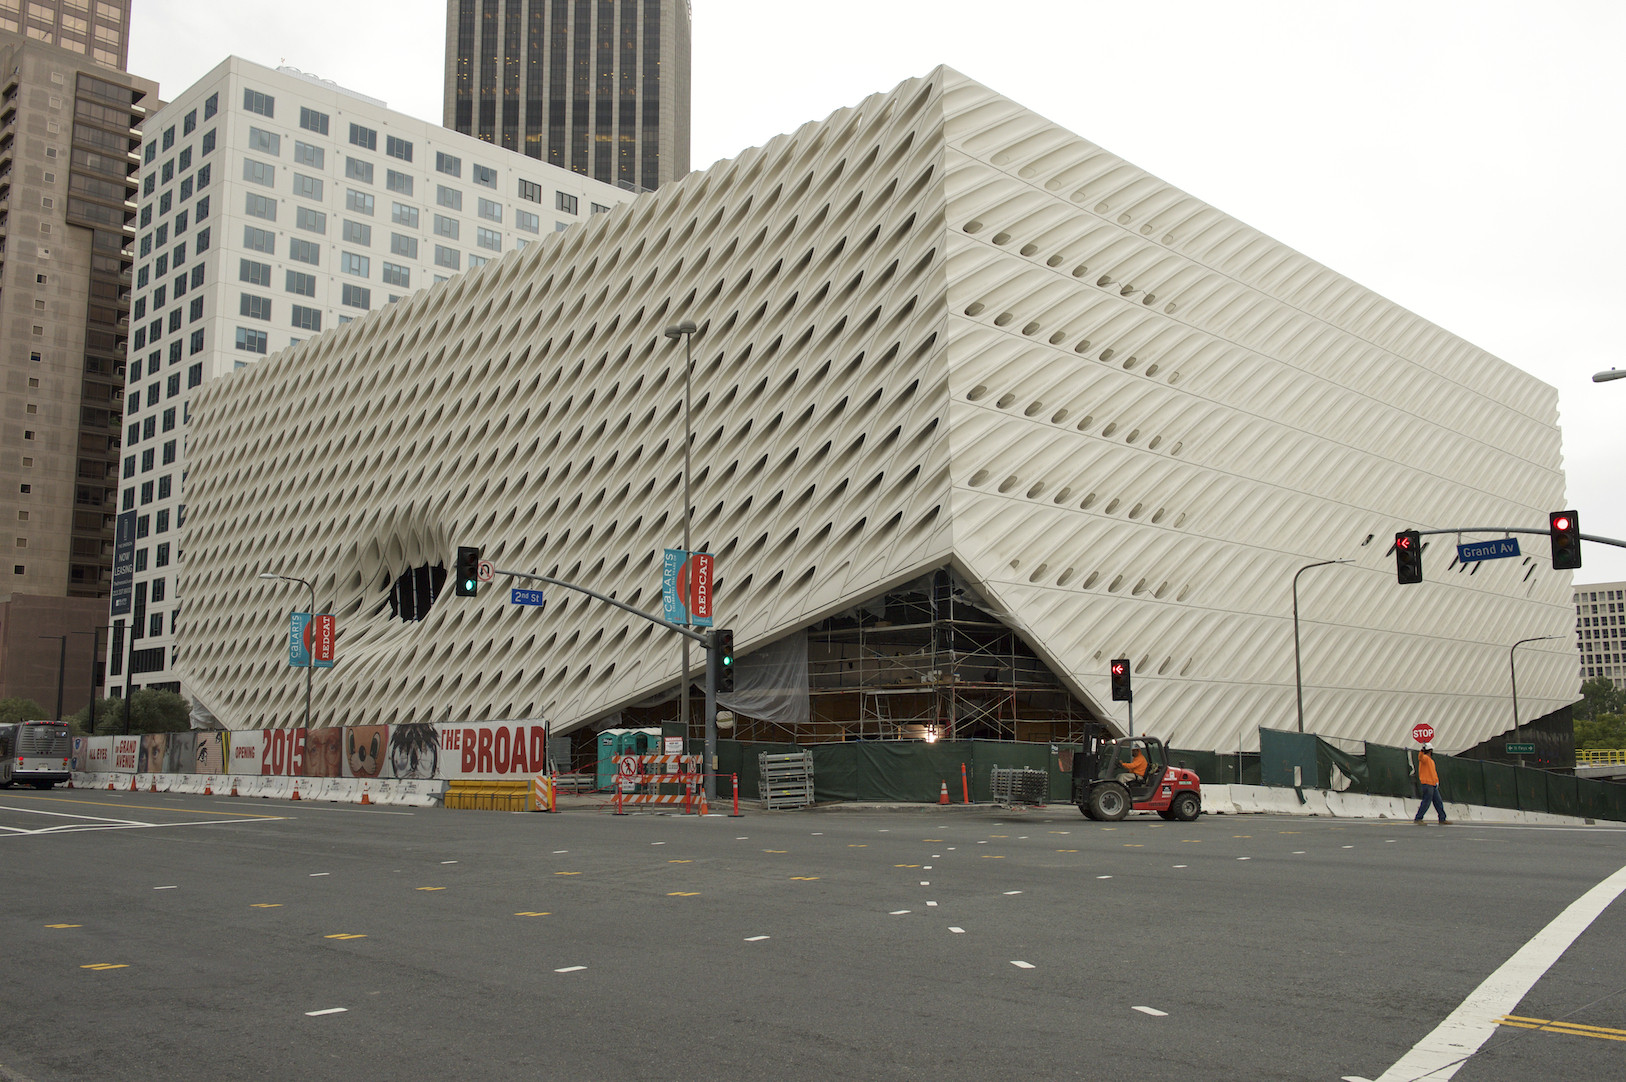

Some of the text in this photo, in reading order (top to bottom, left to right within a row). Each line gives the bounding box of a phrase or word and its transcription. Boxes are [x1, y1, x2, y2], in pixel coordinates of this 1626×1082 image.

[118, 551, 131, 562] NOW
[1463, 543, 1514, 558] Grand Av
[114, 563, 133, 576] LEASING
[698, 556, 708, 615] REDCAT
[514, 591, 540, 603] 2nd St
[322, 616, 331, 659] REDCAT
[1413, 728, 1434, 738] STOP
[119, 740, 137, 753] GRAND
[235, 728, 307, 777] OPENING 2015
[441, 726, 545, 774] THE BROAD
[96, 748, 108, 760] EYES
[116, 754, 135, 768] AVENUE
